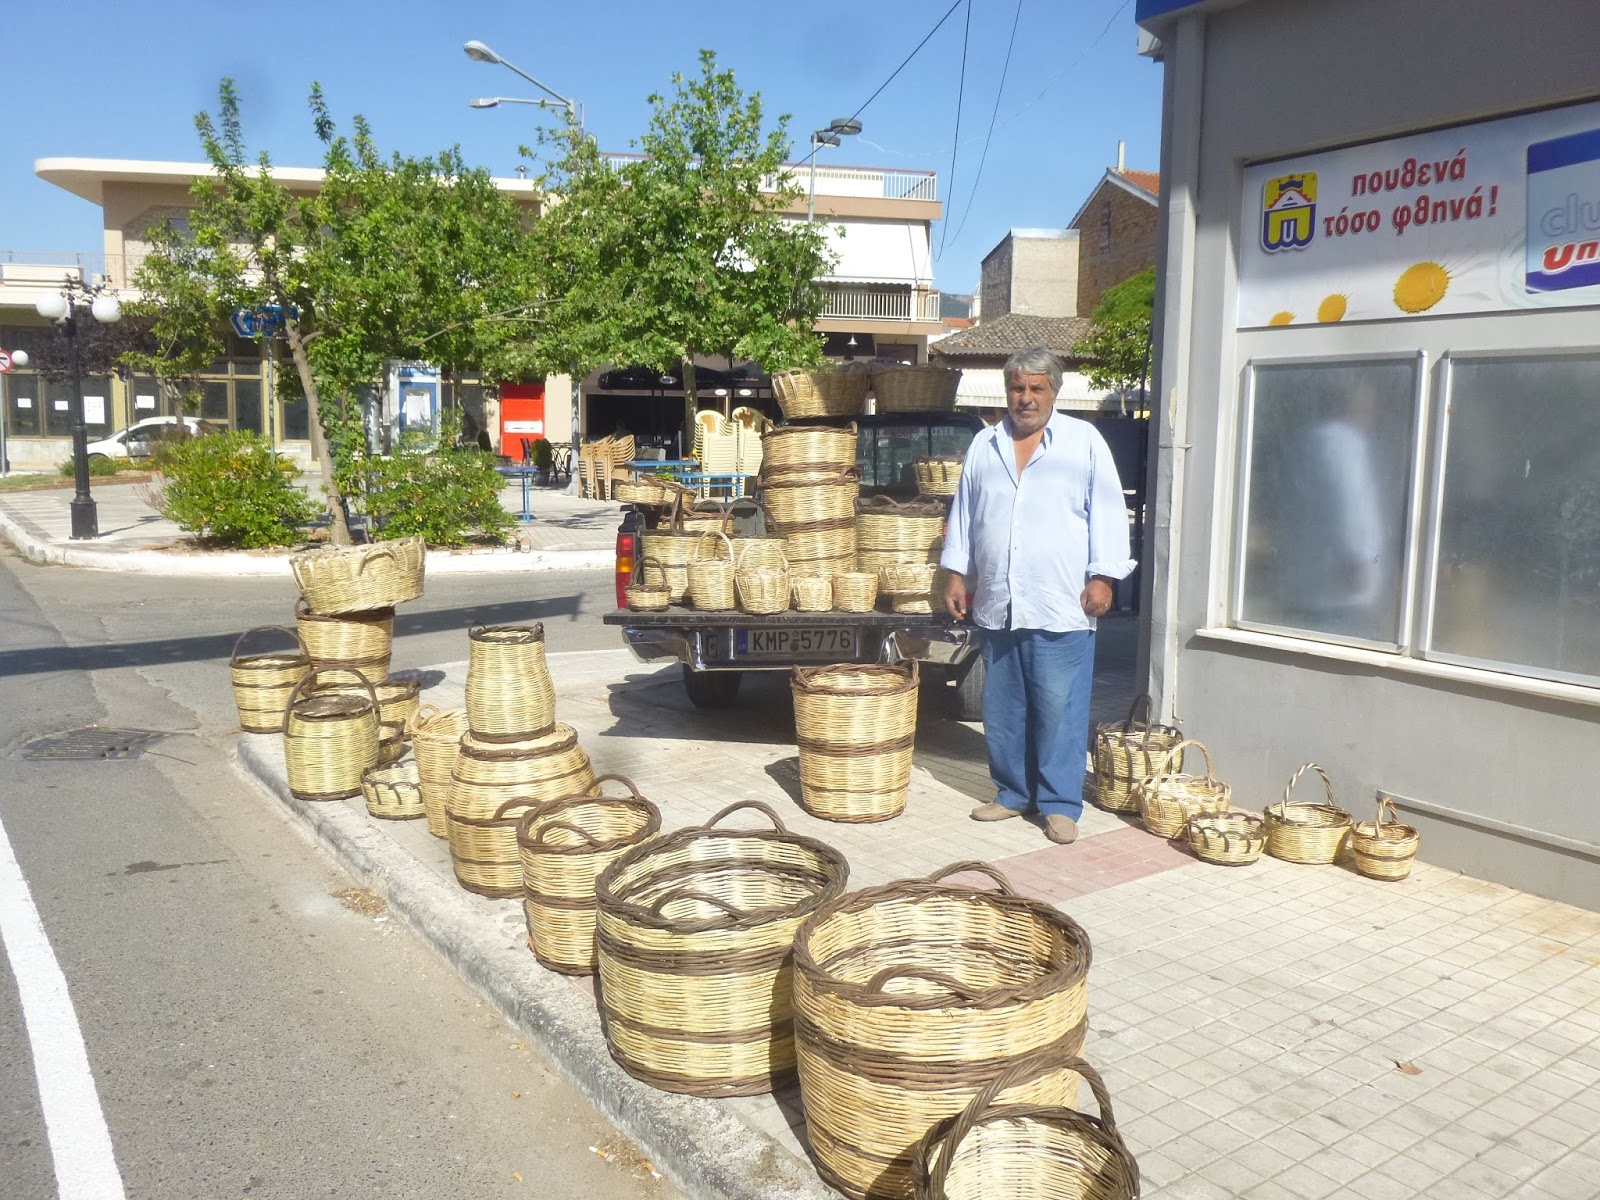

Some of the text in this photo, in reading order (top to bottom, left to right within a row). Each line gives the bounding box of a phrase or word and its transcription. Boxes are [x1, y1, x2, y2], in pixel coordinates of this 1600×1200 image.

[1352, 148, 1466, 197] πουθενά
[1323, 185, 1498, 237] τόσο φθηνά!
